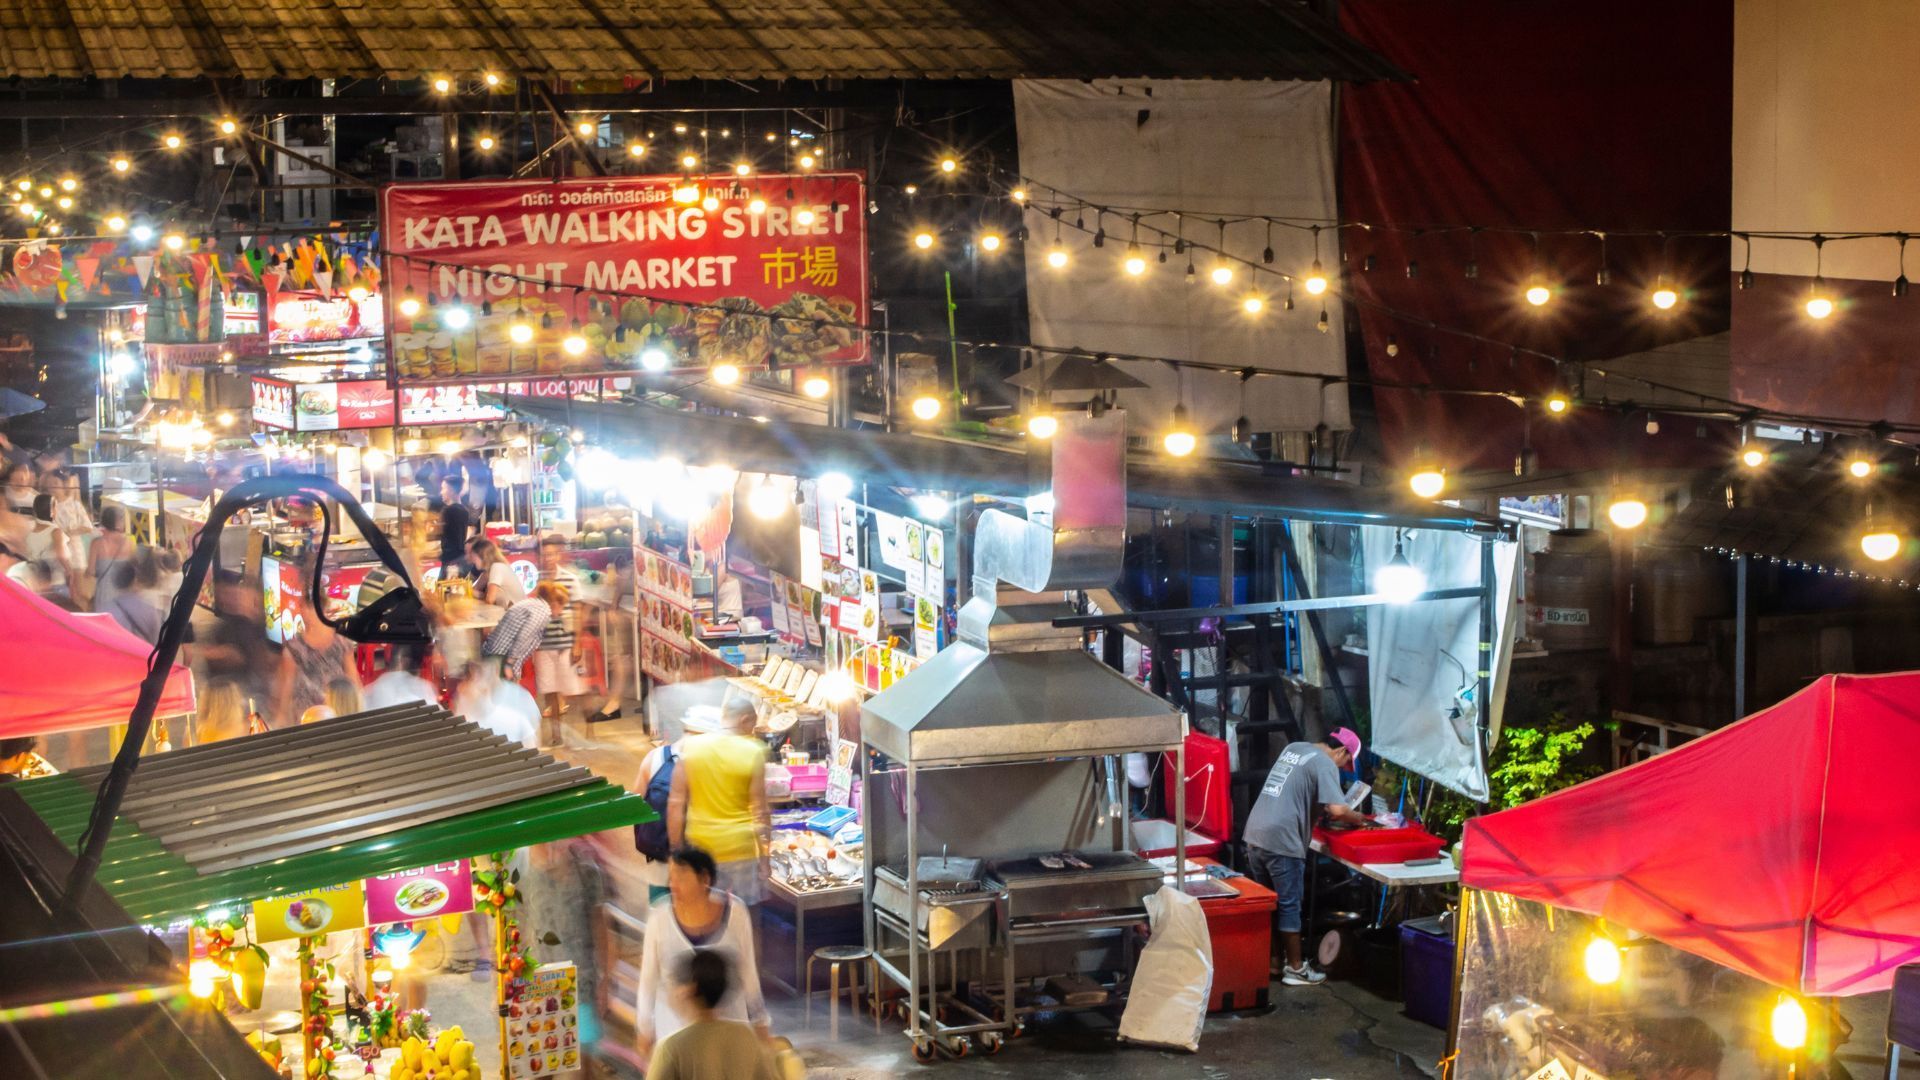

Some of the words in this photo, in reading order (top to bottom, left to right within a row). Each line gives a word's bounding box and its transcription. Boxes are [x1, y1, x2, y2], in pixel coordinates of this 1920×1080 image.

[404, 215, 502, 249] KATA
[520, 208, 707, 246] WALKING
[722, 203, 850, 239] STREET
[439, 261, 568, 298] NIGHT
[583, 255, 738, 291] MARKET
[759, 246, 839, 289] 市場
